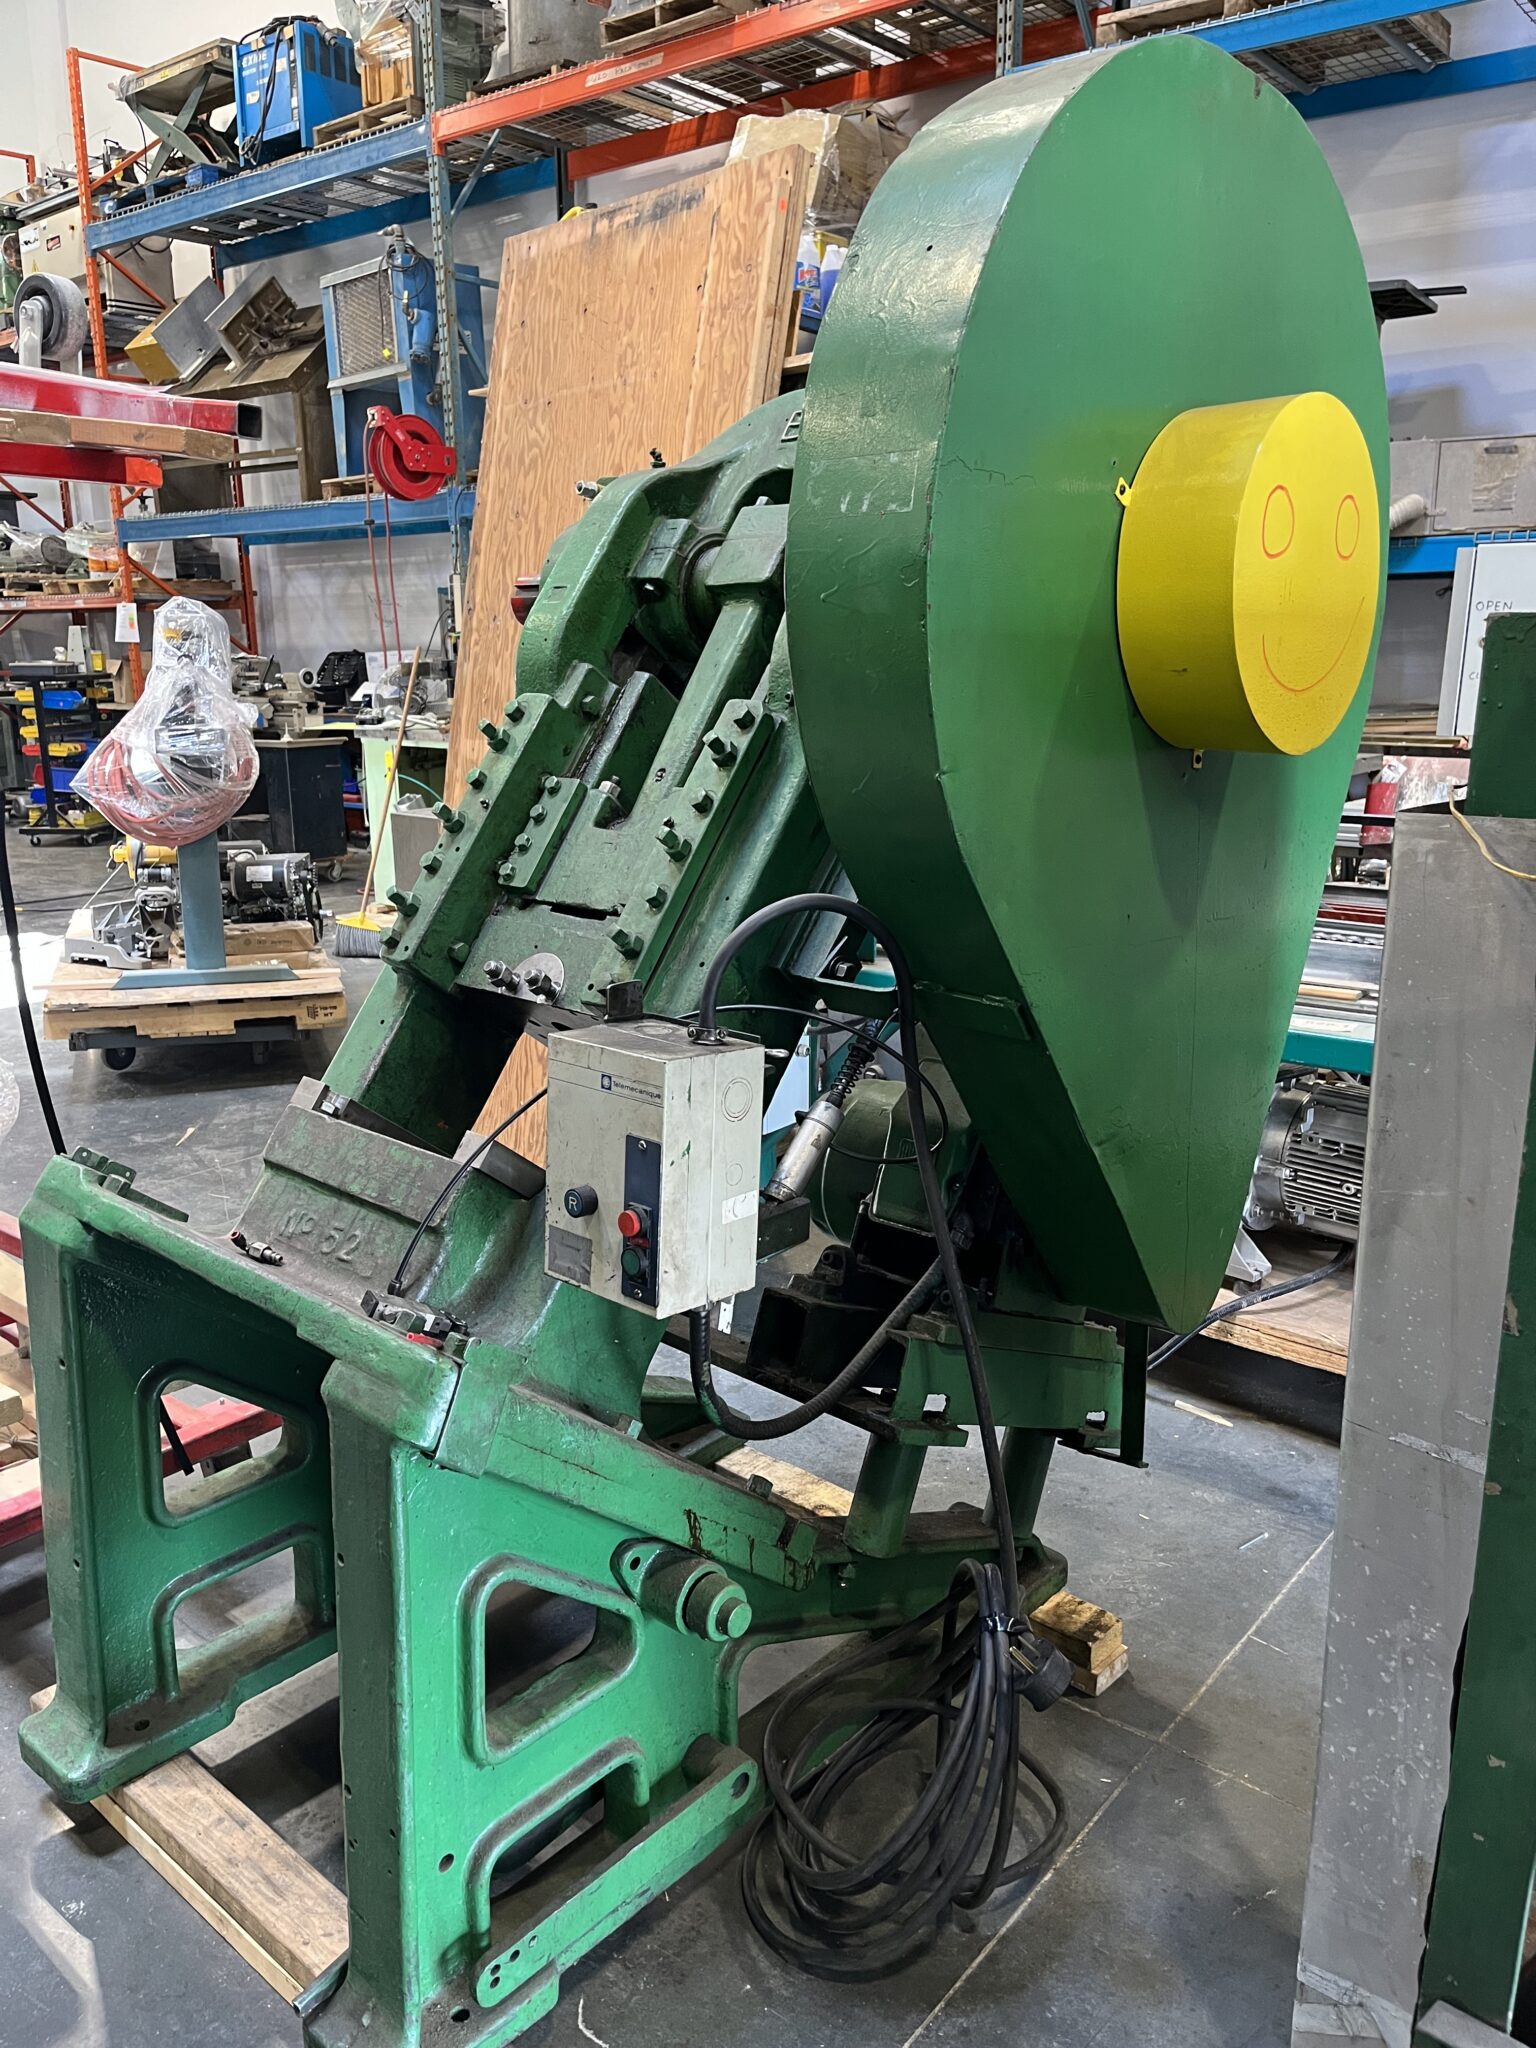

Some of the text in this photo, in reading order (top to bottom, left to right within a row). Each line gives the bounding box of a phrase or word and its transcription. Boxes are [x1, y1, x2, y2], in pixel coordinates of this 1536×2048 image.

[1475, 600, 1513, 611] OPEN
[613, 1080, 662, 1099] Telemecanique
[568, 1196, 578, 1211] R
[320, 1224, 361, 1263] 52
